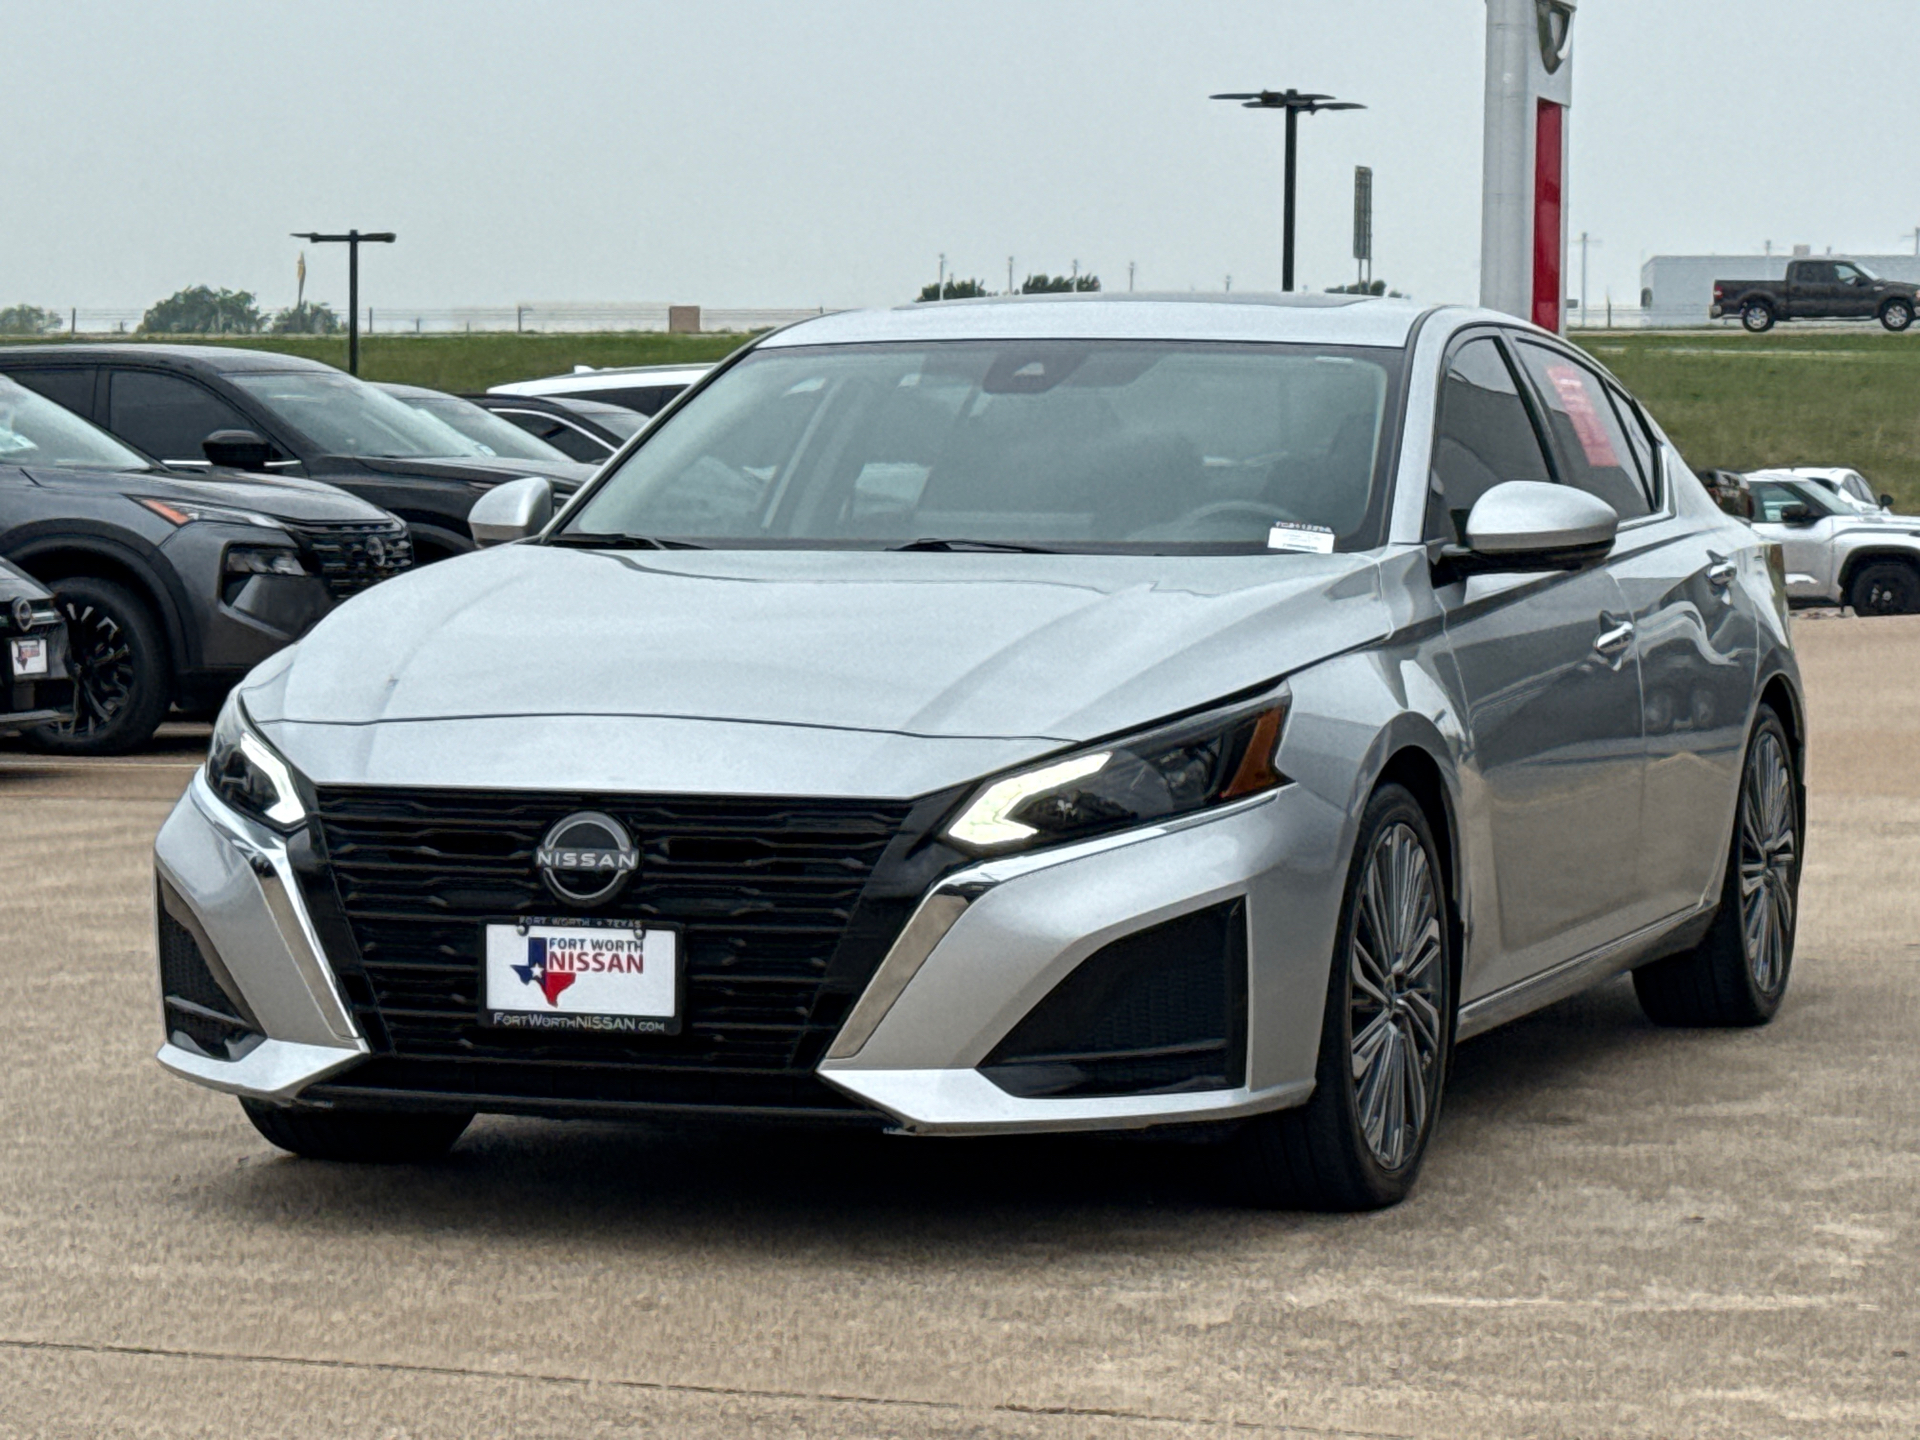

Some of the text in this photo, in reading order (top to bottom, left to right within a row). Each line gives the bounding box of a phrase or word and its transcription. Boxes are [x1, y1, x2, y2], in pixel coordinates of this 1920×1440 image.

[537, 852, 637, 868] NISSAN
[519, 916, 547, 925] FORT
[551, 917, 590, 927] WORTH
[549, 938, 643, 952] FORT WORTH
[548, 951, 644, 974] NISSAN
